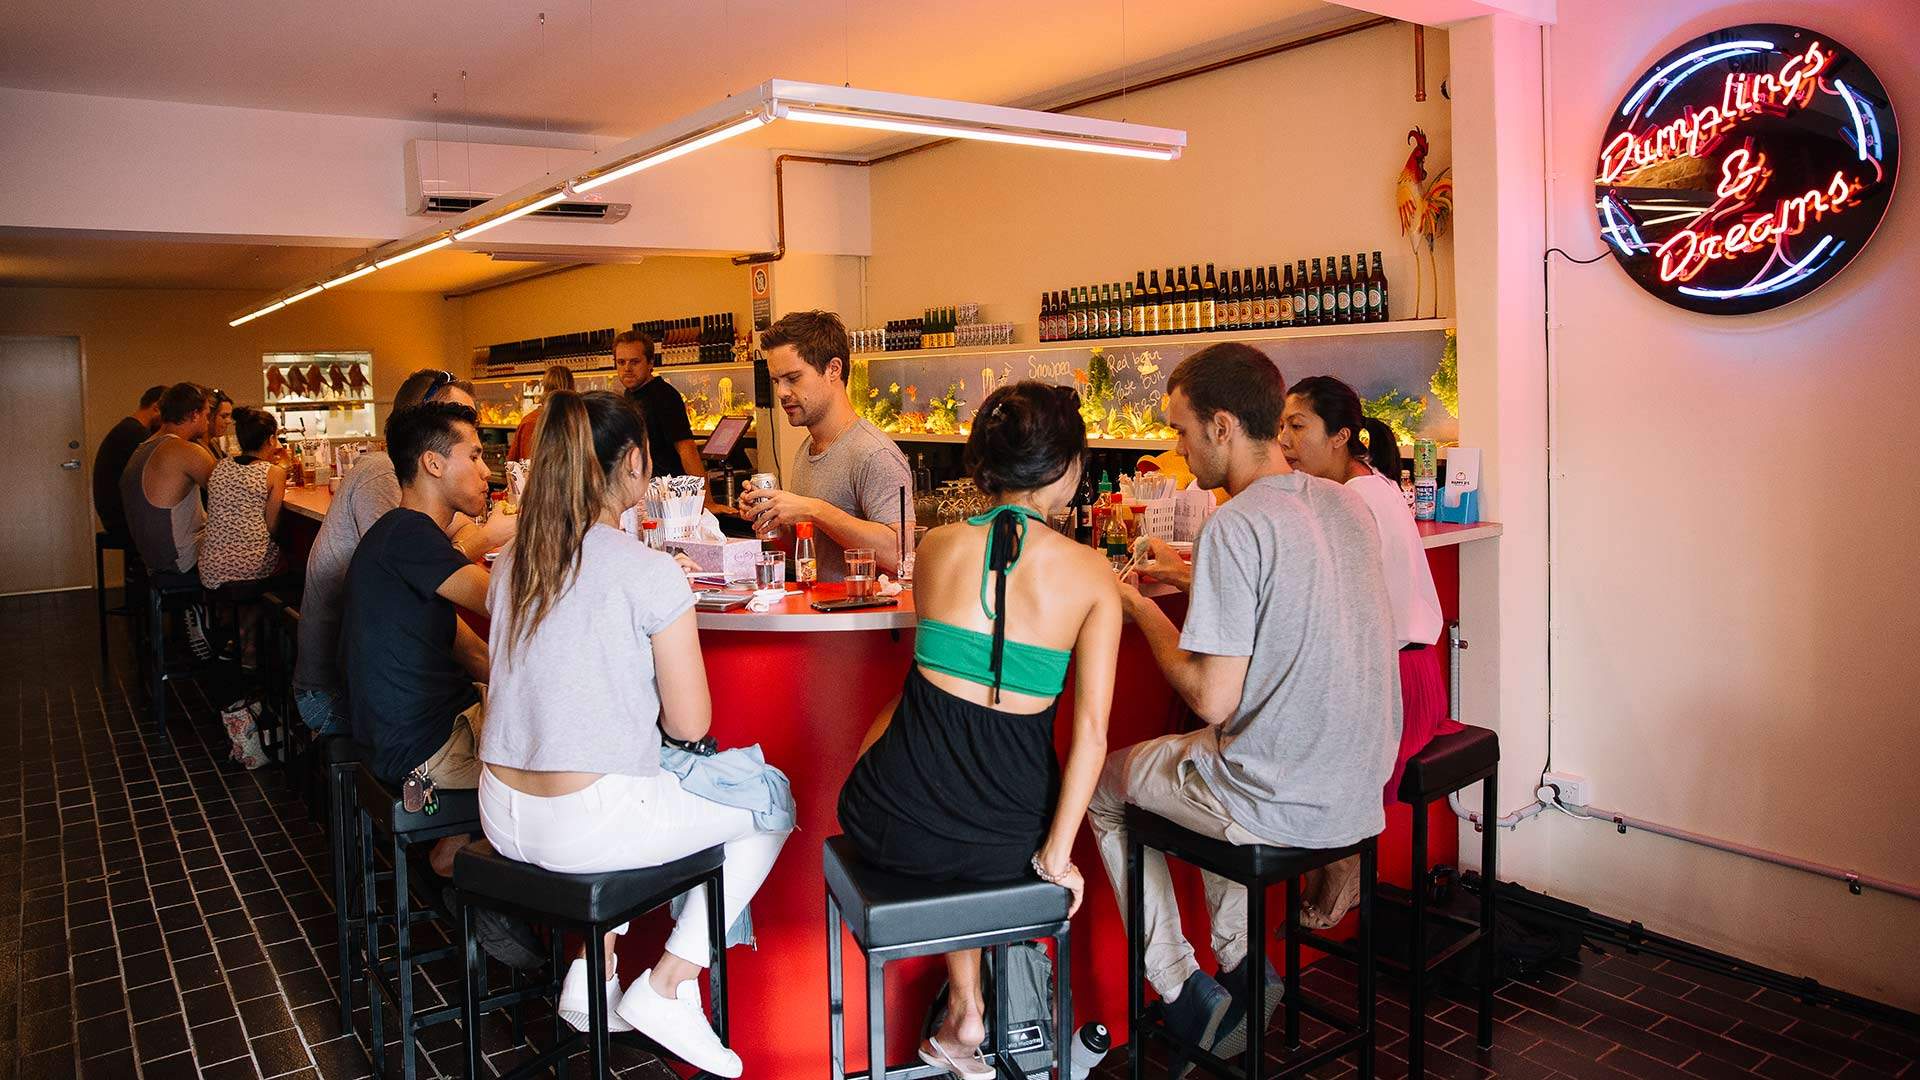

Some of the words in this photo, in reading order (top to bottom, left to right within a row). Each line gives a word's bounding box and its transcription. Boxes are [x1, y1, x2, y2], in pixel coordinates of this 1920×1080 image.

[1601, 41, 1825, 184] Dumplings
[1717, 149, 1762, 198] &
[1655, 170, 1849, 282] Dreams
[1106, 354, 1130, 377] Red
